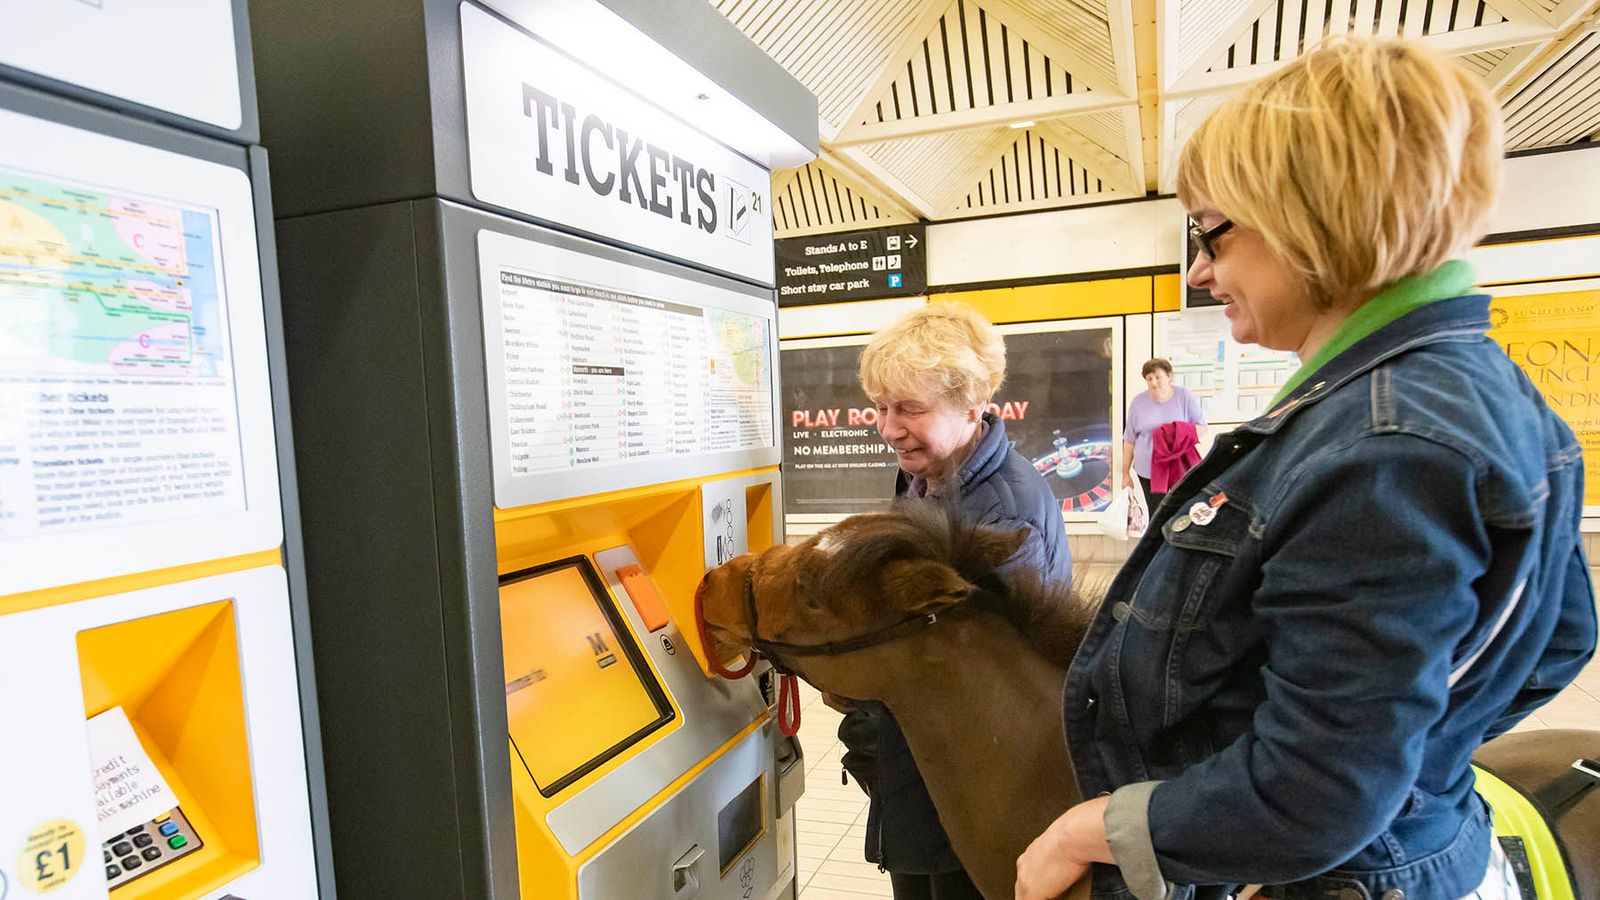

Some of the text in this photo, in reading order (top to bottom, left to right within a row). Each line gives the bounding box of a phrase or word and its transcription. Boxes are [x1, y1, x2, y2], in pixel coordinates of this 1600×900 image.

[522, 81, 718, 235] TICKETS
[752, 192, 762, 214] 21
[805, 240, 868, 256] Stands A to E
[784, 260, 870, 276] Toilets, Telephone
[780, 278, 870, 295] Short stay car park
[792, 408, 840, 428] PLAY
[793, 430, 868, 439] LIVE ELECTRONIC
[794, 446, 811, 456] NO
[813, 444, 885, 455] MEMBERSHIP
[118, 784, 161, 810] machine
[36, 842, 70, 881] £1
